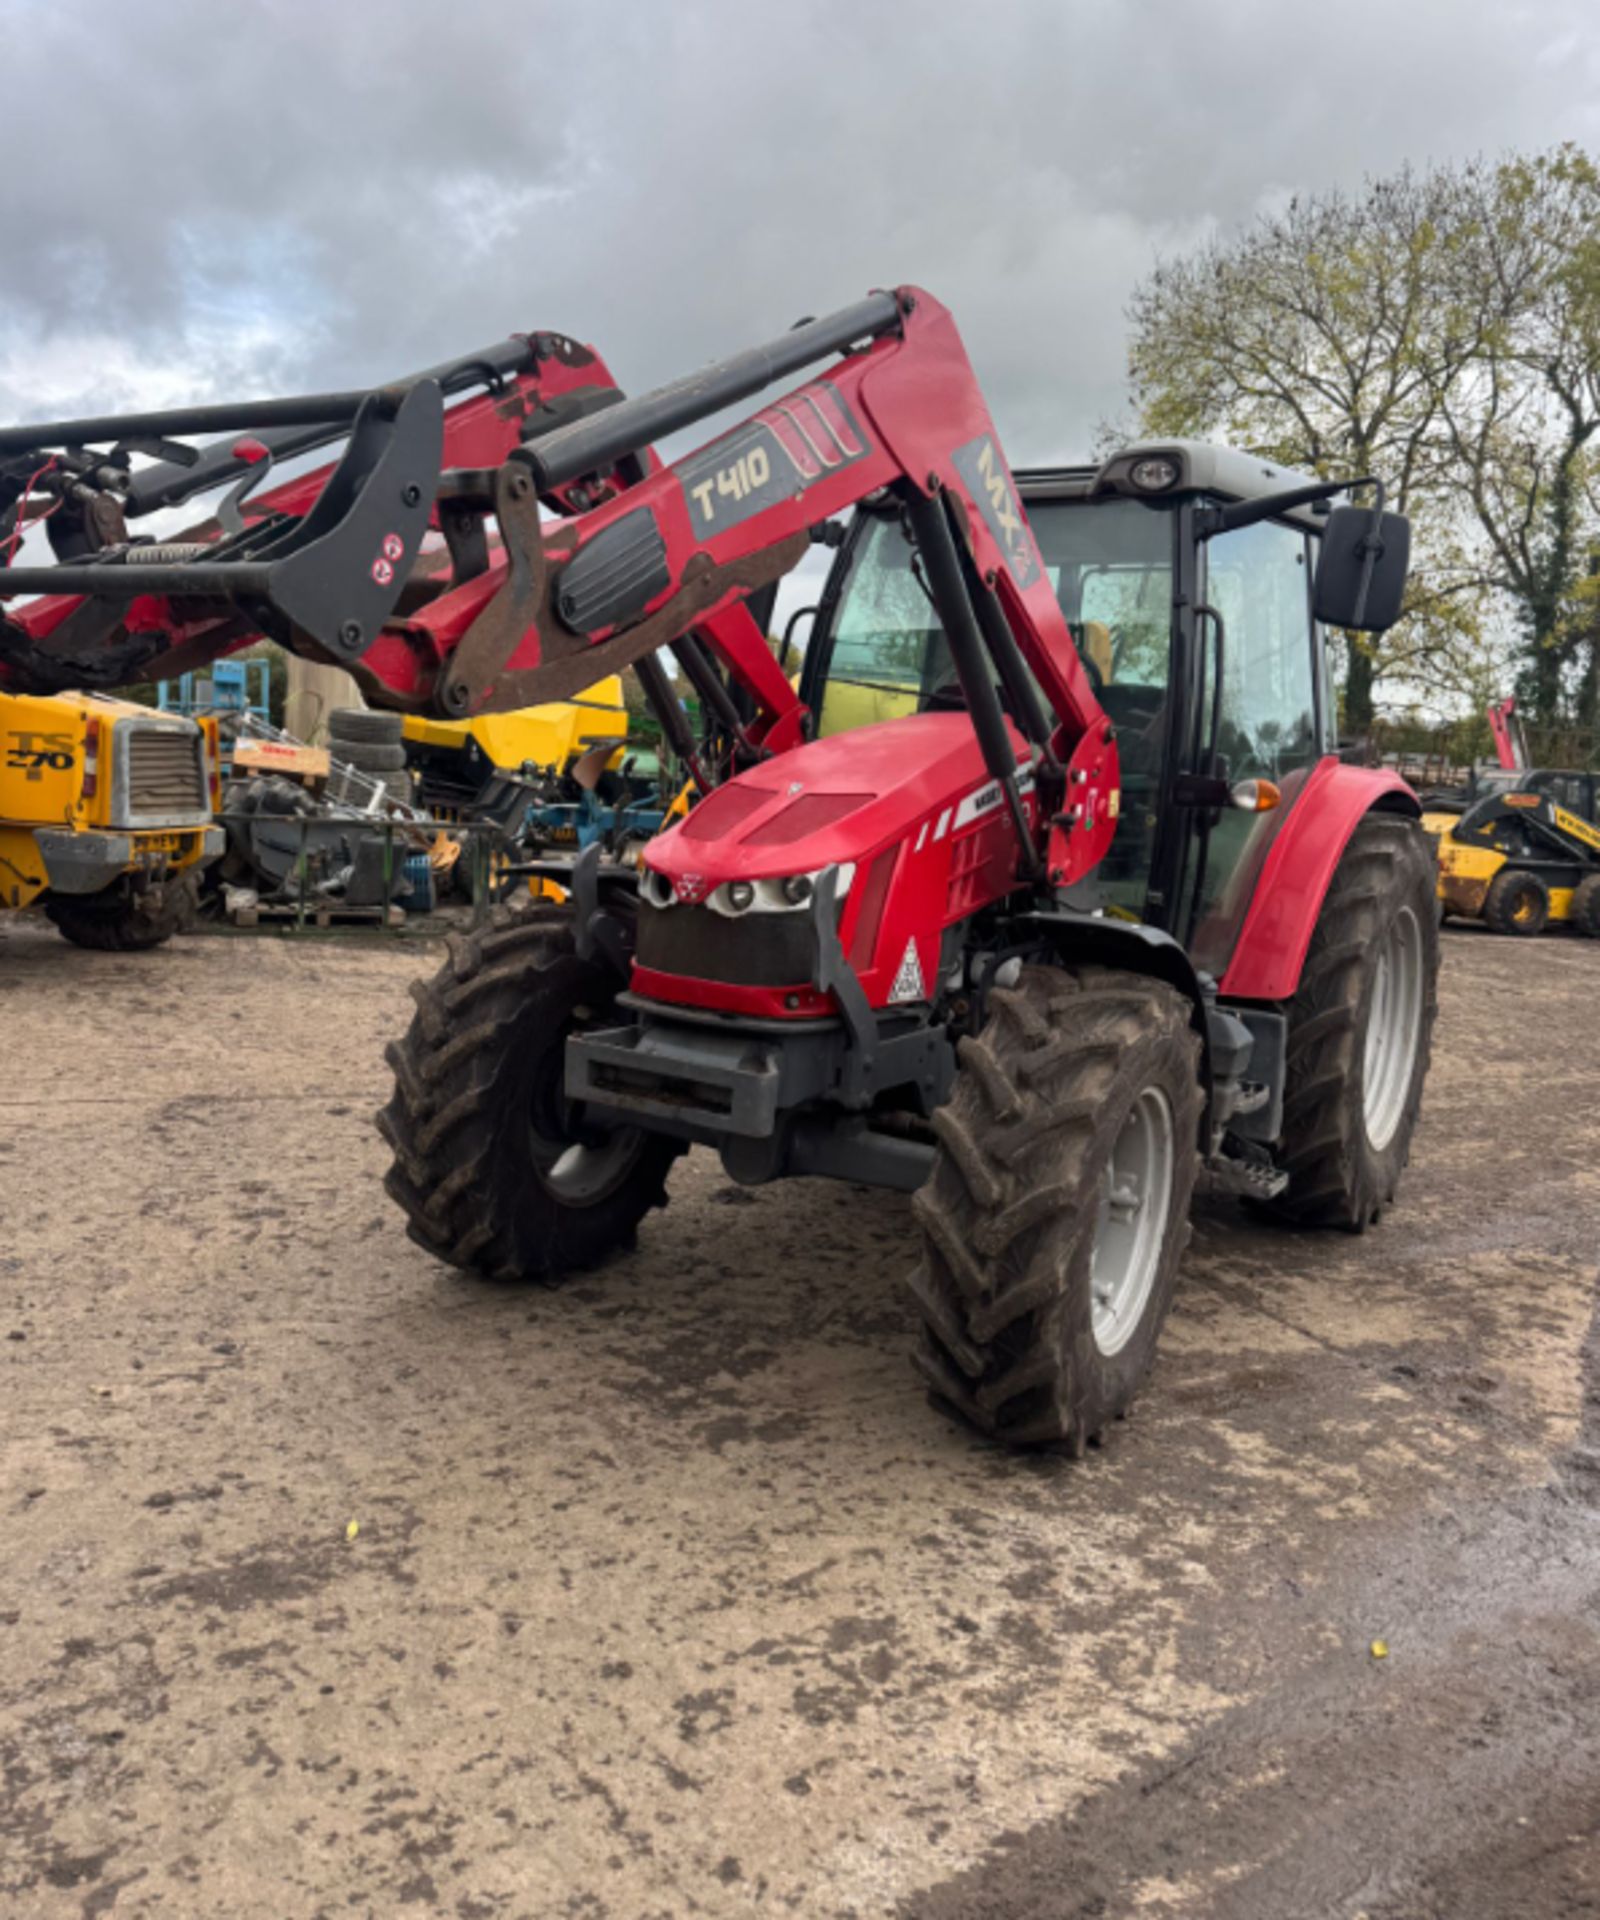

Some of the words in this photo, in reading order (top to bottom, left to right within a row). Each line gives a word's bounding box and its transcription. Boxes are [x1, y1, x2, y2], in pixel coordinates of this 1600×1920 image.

[691, 446, 770, 522] T410
[978, 441, 1022, 548] MX
[7, 731, 74, 754] TS
[7, 750, 75, 771] 270
